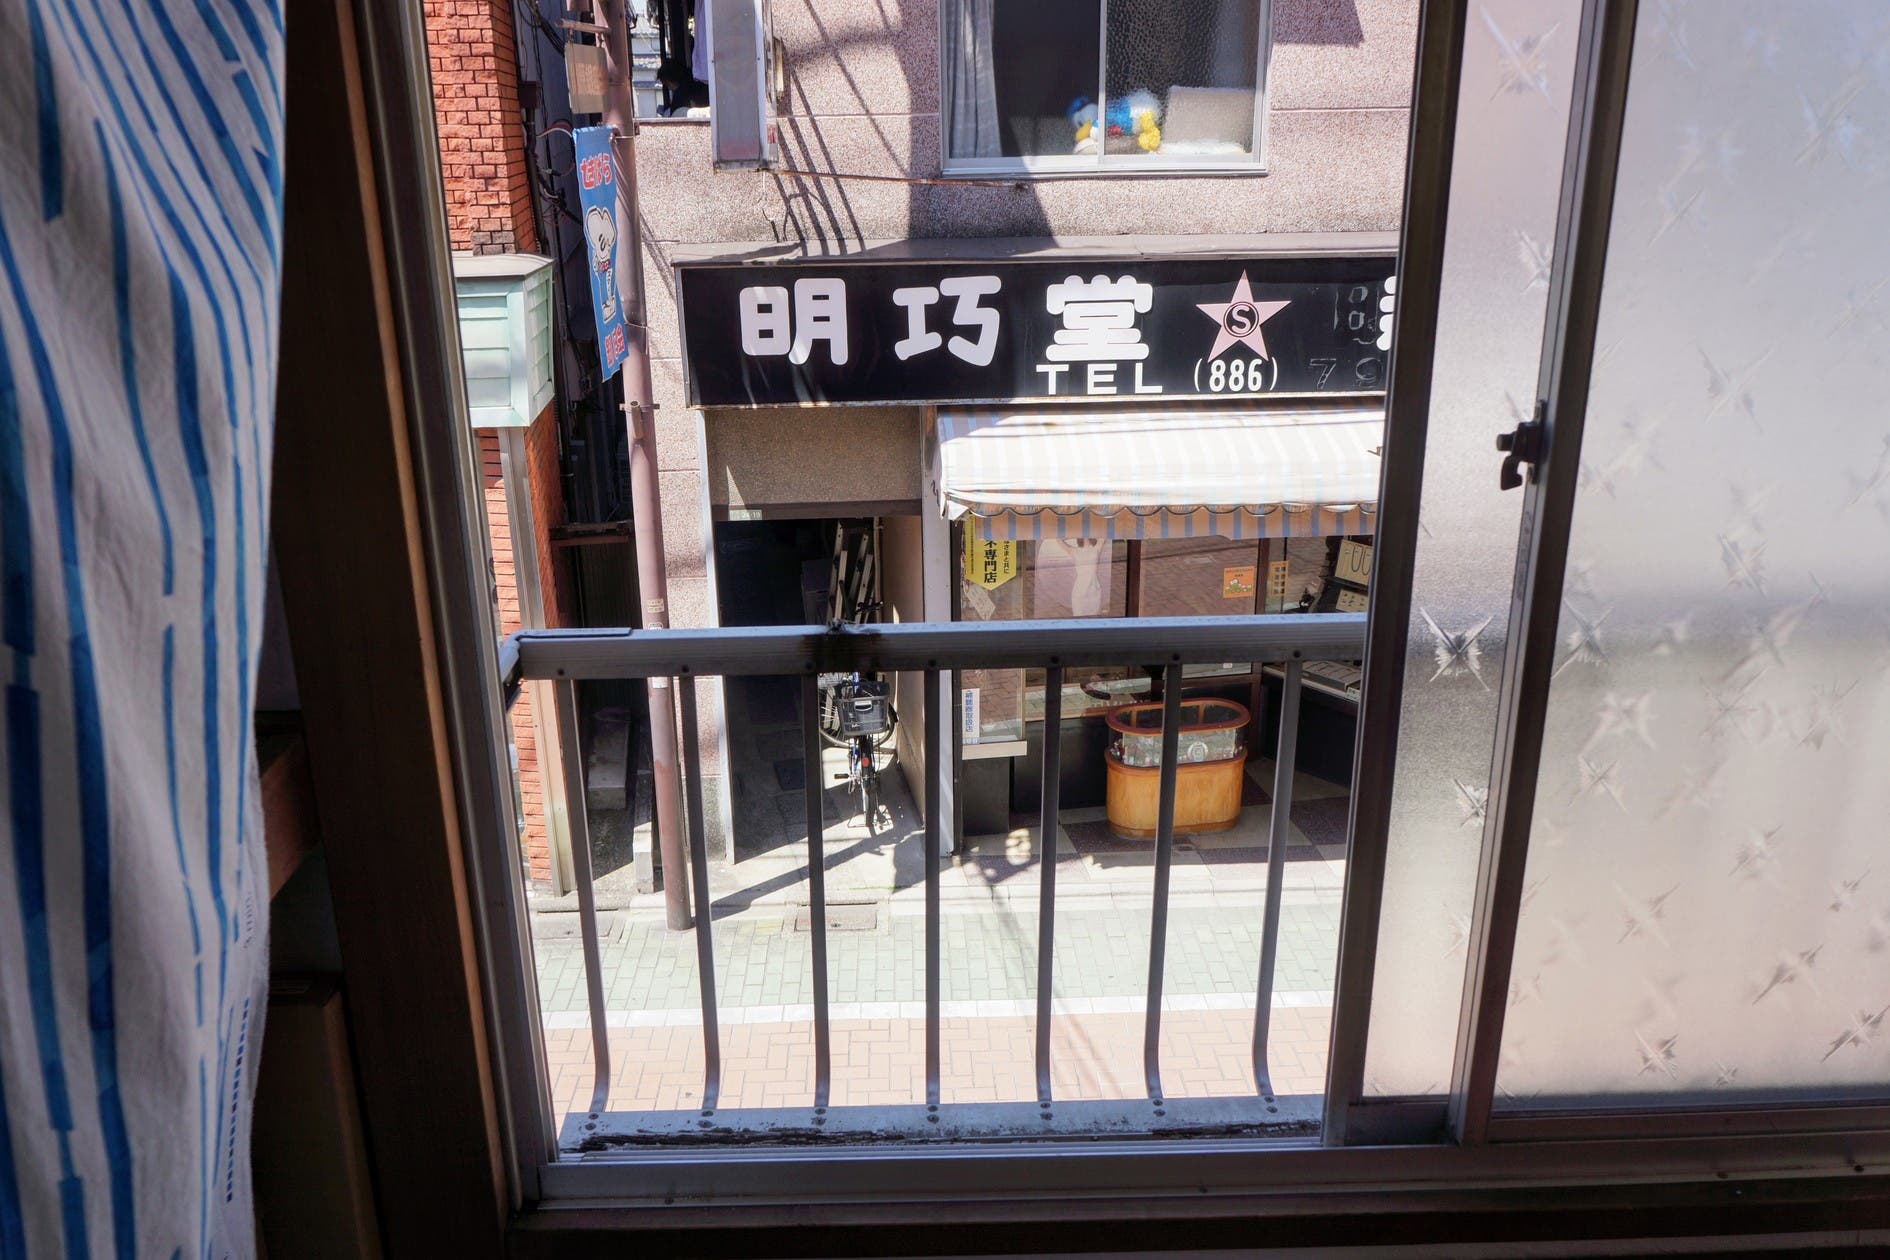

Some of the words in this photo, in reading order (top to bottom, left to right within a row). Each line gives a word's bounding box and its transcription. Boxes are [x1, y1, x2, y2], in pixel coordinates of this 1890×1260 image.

[739, 274, 1153, 366] 明巧堂
[1230, 305, 1251, 333] S
[1035, 362, 1163, 395] TEL
[1193, 358, 1279, 393] (886)
